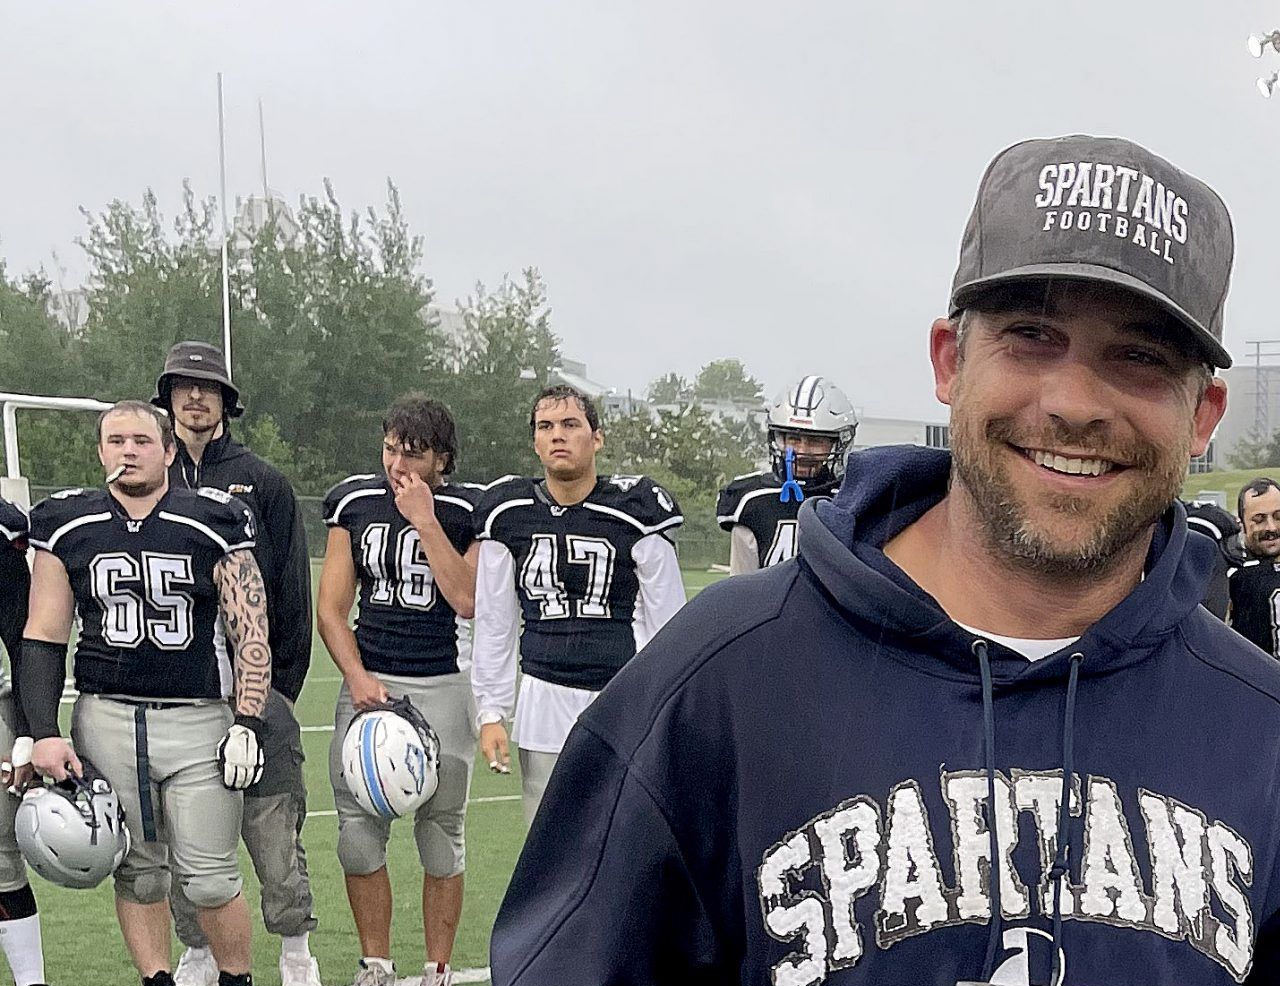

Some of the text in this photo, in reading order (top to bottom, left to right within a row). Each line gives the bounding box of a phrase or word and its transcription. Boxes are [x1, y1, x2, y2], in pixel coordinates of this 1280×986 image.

[1035, 161, 1188, 244] SPARTANS
[1043, 211, 1174, 264] FOOTBALL
[89, 551, 195, 650] 65
[361, 522, 437, 612] 16
[519, 534, 617, 620] 47
